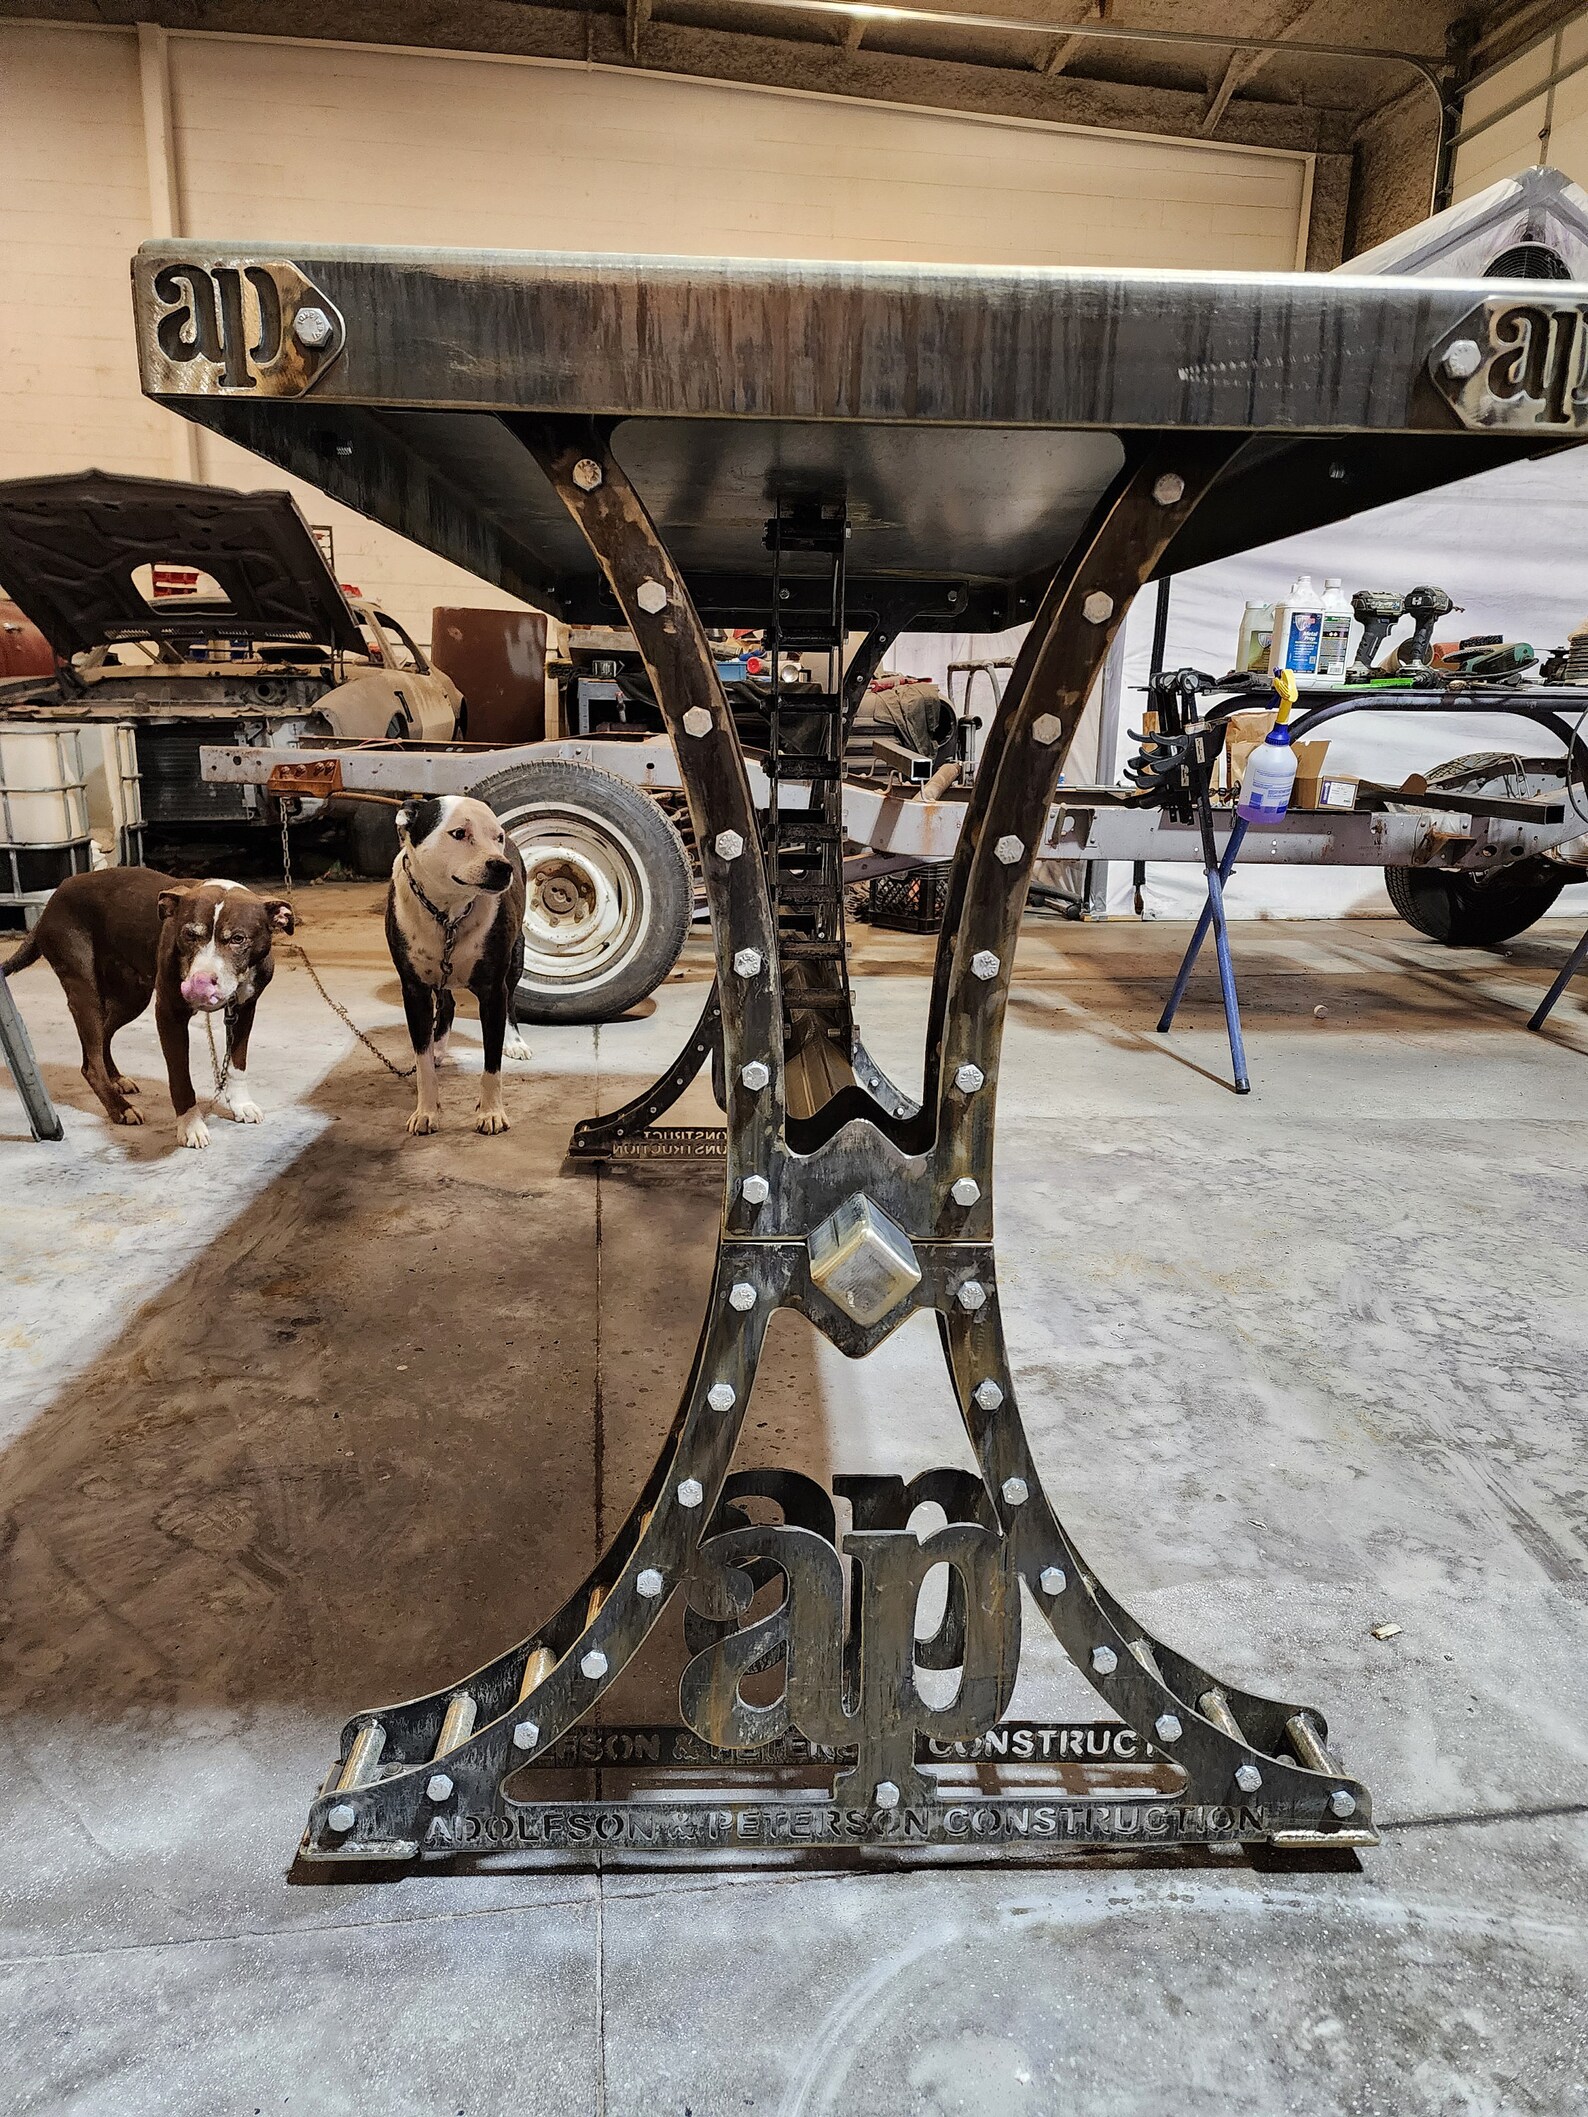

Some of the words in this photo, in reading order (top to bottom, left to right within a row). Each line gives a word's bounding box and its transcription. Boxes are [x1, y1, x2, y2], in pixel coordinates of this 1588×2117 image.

[154, 263, 282, 388] ap
[679, 1523, 1022, 1801] ap
[928, 1729, 1153, 1759] CONSTRUC
[423, 1812, 655, 1843] ADOLFSON
[667, 1811, 701, 1842] &
[707, 1808, 930, 1841] PETERSON
[943, 1806, 1267, 1836] CONSTRUCTION
